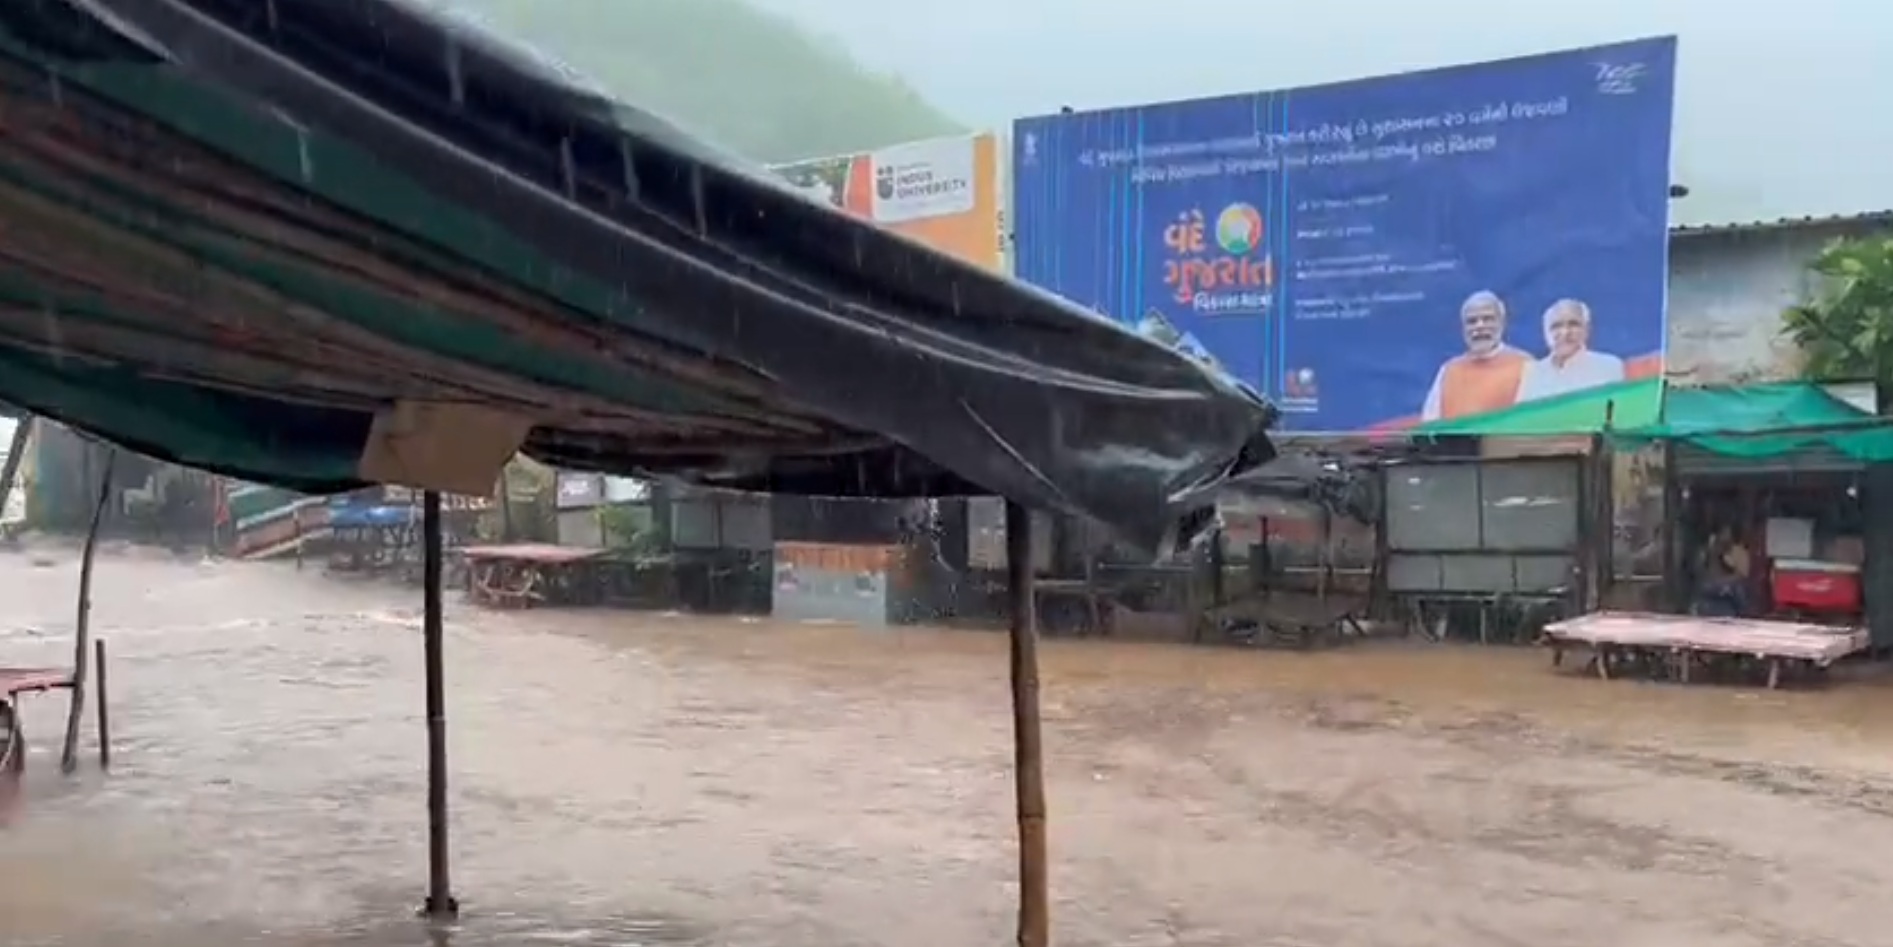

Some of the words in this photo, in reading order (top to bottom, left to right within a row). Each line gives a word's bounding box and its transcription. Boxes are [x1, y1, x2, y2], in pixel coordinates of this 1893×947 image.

[897, 171, 933, 187] INDUS
[897, 178, 966, 200] UNIVERSITY
[1163, 208, 1206, 254] વંદે
[1163, 255, 1274, 304] ગુજરાત
